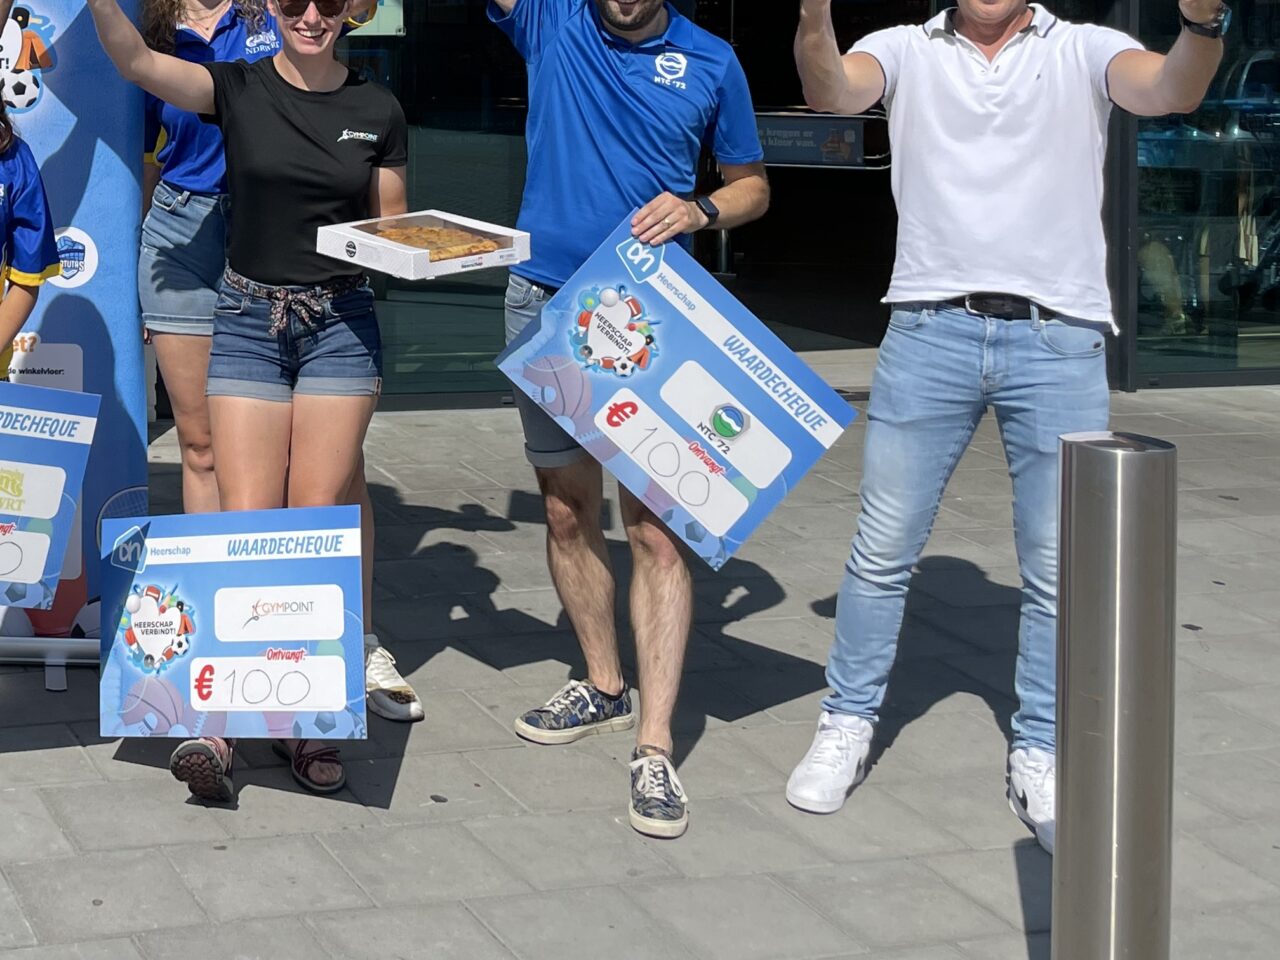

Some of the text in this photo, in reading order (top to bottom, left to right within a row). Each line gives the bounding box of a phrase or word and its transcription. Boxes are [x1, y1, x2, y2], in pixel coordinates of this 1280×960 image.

[657, 271, 697, 312] Heerschap
[594, 311, 634, 348] HEERSCHAP
[18, 367, 65, 375] winkelvloer:
[722, 333, 829, 432] WAARDECHEQUE
[605, 401, 711, 507] € 100
[696, 421, 731, 455] NTC '72
[150, 545, 191, 557] Heerschap
[227, 535, 344, 557] WAARDECHEQUE
[262, 601, 314, 613] GYMPOINT
[134, 620, 174, 629] HEERSCHAP
[194, 664, 311, 705] € 100
